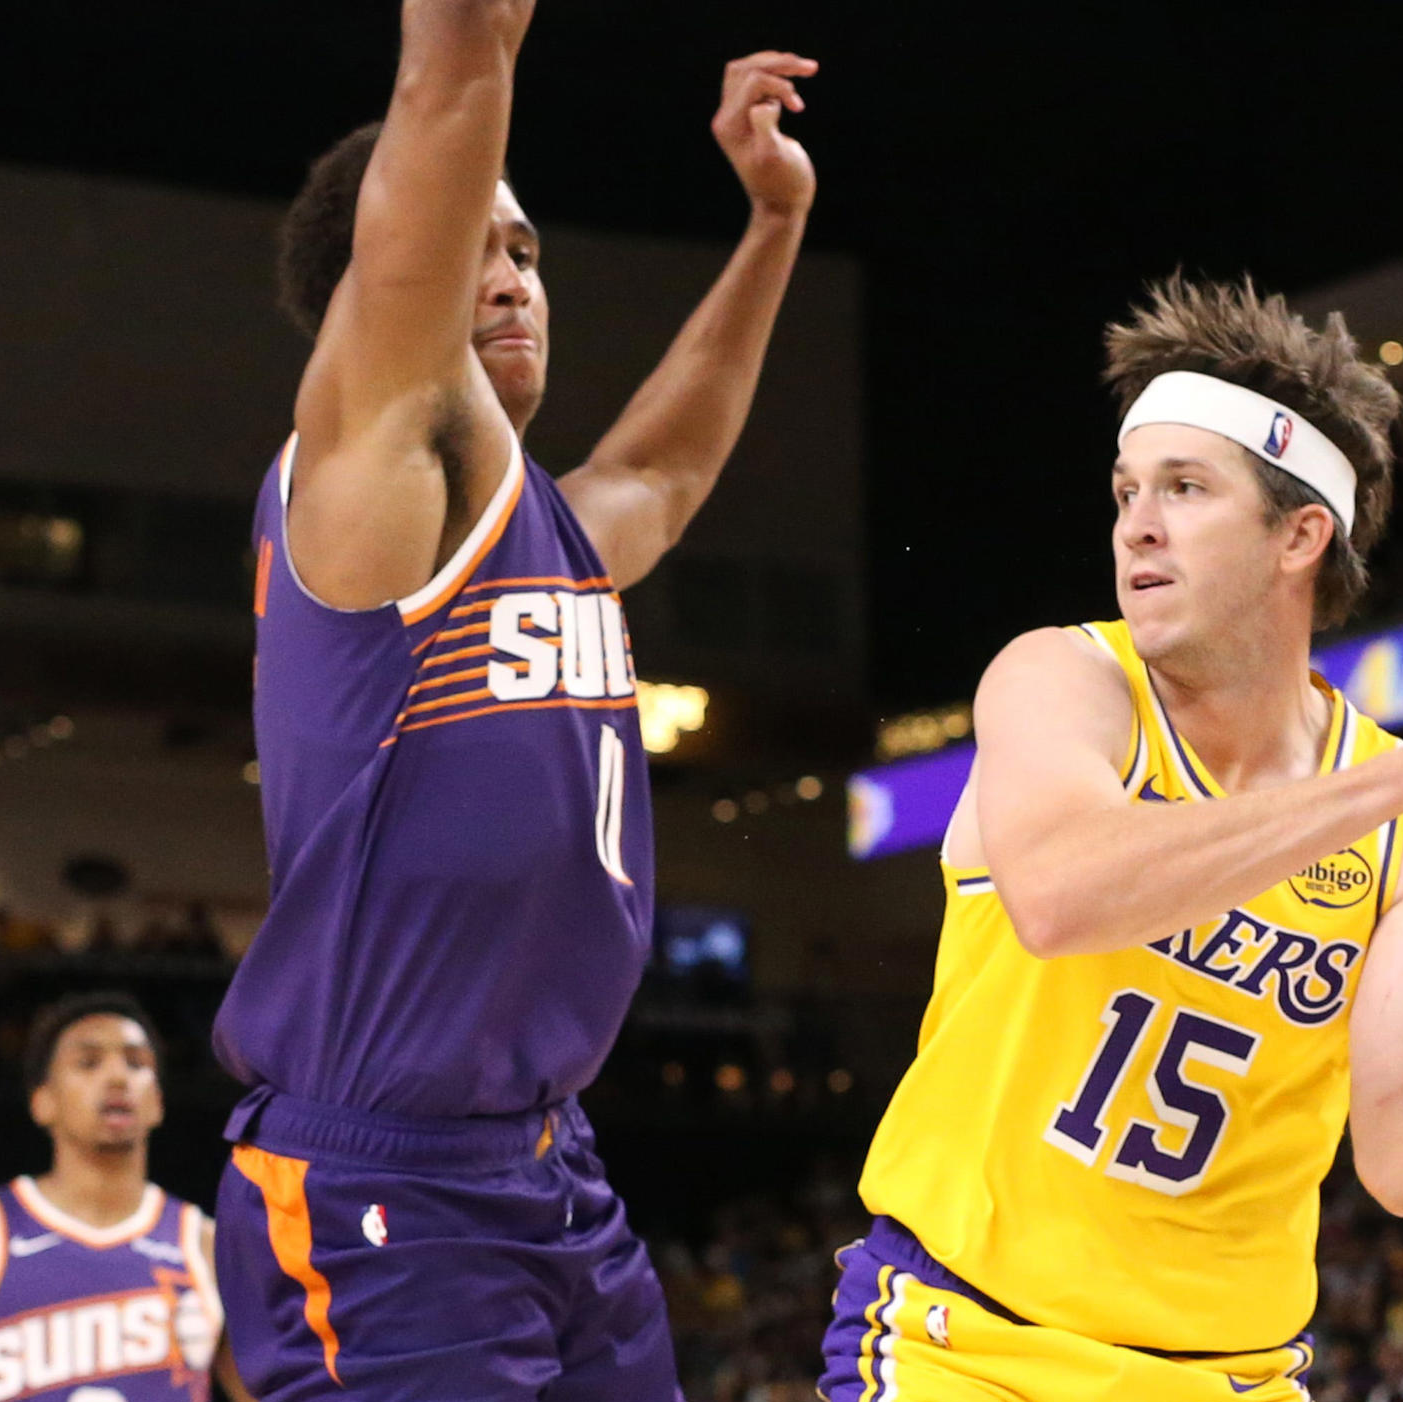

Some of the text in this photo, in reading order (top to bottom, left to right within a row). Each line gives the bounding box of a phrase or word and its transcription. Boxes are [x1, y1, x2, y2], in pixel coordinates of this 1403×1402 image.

[487, 591, 635, 700] SU
[1295, 861, 1367, 891] ibigo
[1044, 988, 1261, 1196] 15
